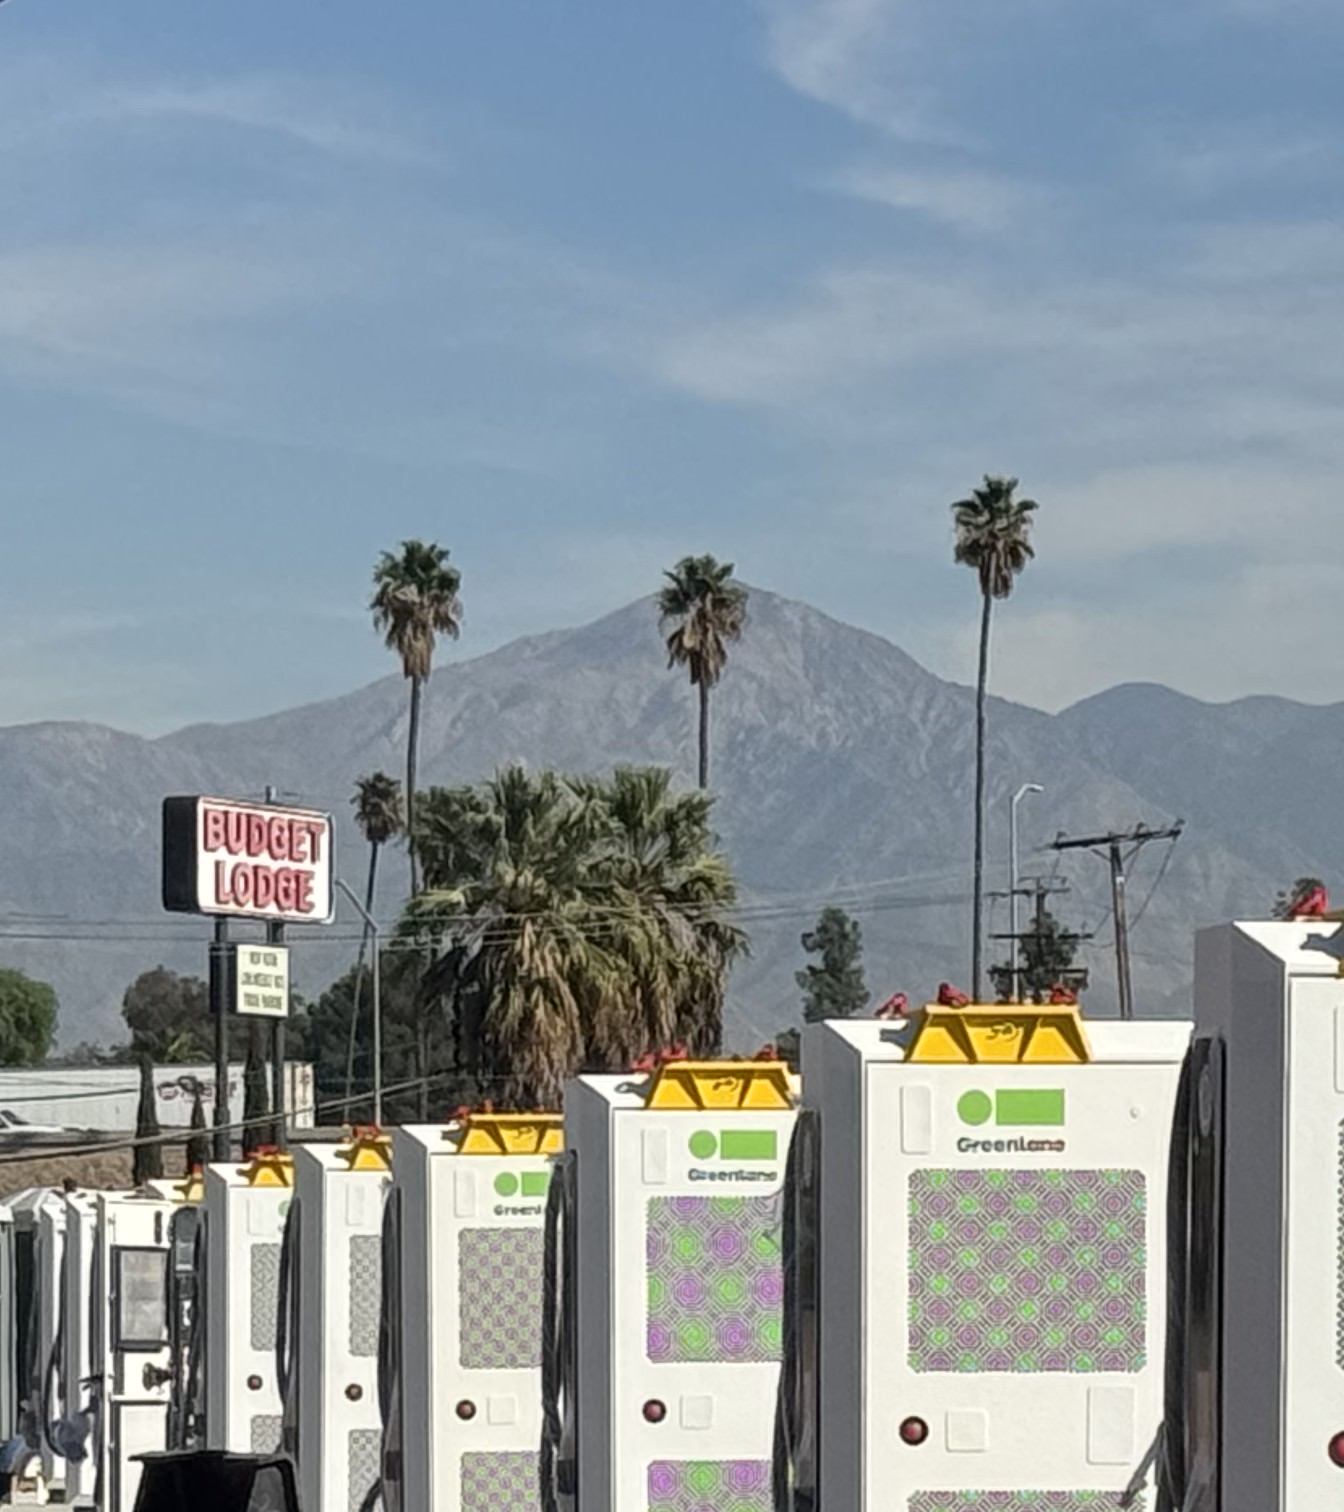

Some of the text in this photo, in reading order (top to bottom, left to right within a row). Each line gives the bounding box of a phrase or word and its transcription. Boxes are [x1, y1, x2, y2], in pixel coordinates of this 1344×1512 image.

[203, 808, 326, 864] BUDGET
[214, 859, 316, 914] LODGE
[957, 1136, 1065, 1153] Greenlane
